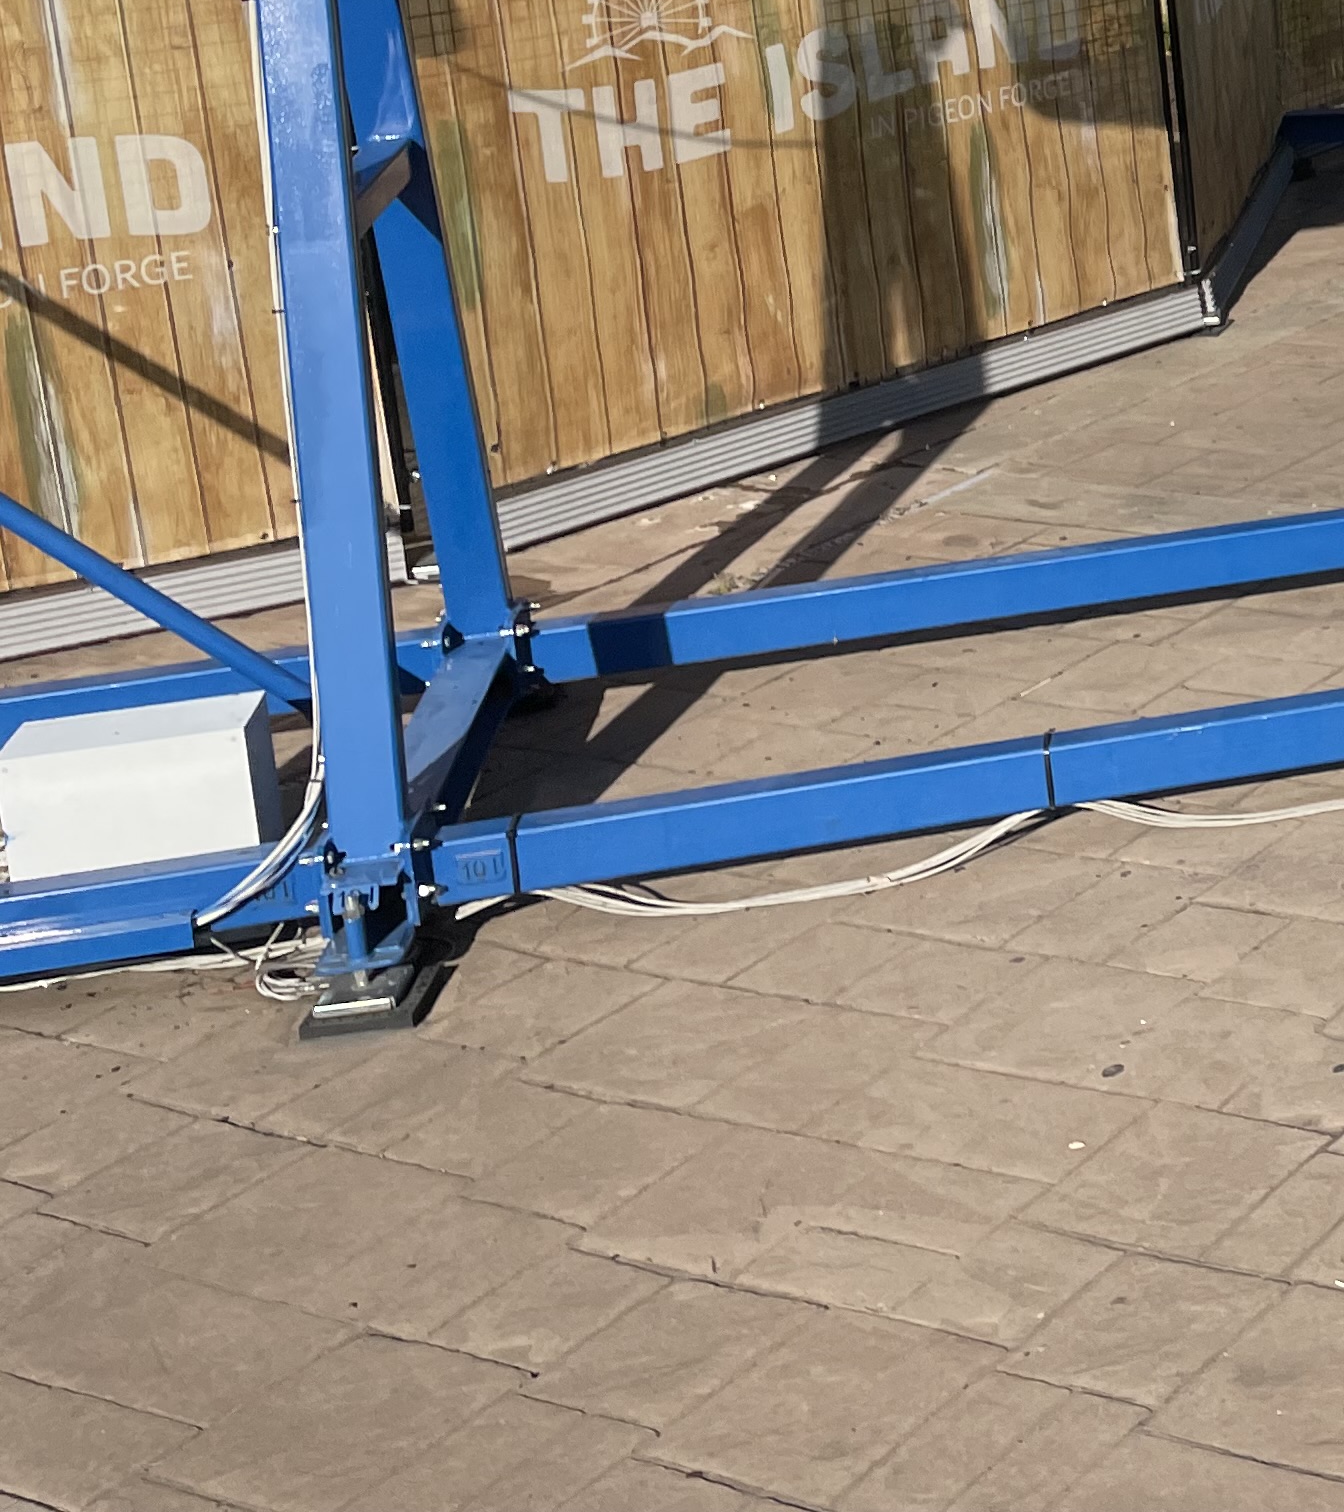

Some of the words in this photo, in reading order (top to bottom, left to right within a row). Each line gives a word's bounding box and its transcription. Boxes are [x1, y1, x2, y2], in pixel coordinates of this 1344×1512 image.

[507, 62, 733, 184] THE
[904, 90, 994, 135] PIGEON
[999, 68, 1073, 110] FORGE
[0, 135, 212, 249] ND
[59, 250, 194, 300] FORGE
